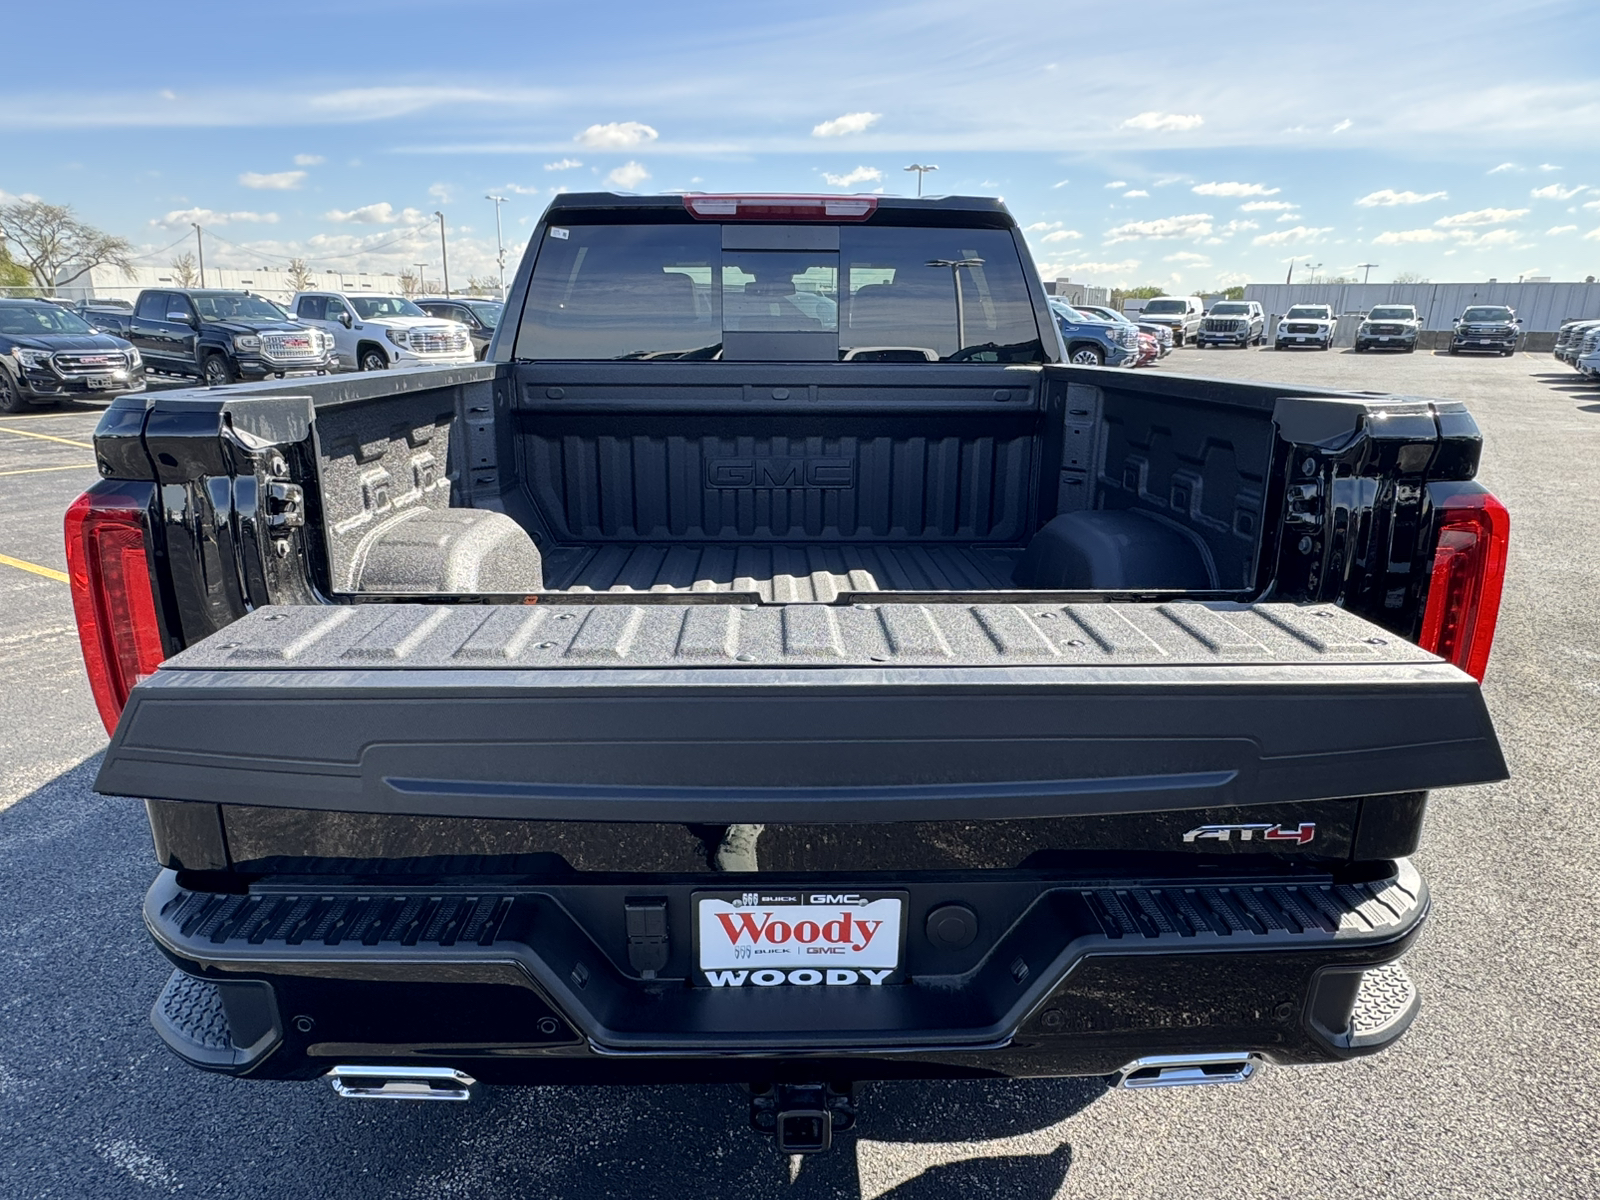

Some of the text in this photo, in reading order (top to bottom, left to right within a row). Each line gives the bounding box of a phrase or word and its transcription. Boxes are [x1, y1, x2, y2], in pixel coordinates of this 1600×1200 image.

[708, 459, 850, 486] GMC
[1183, 823, 1315, 845] AT4
[810, 895, 860, 904] GMC
[714, 912, 883, 952] Woody
[705, 970, 893, 987] WOODY
